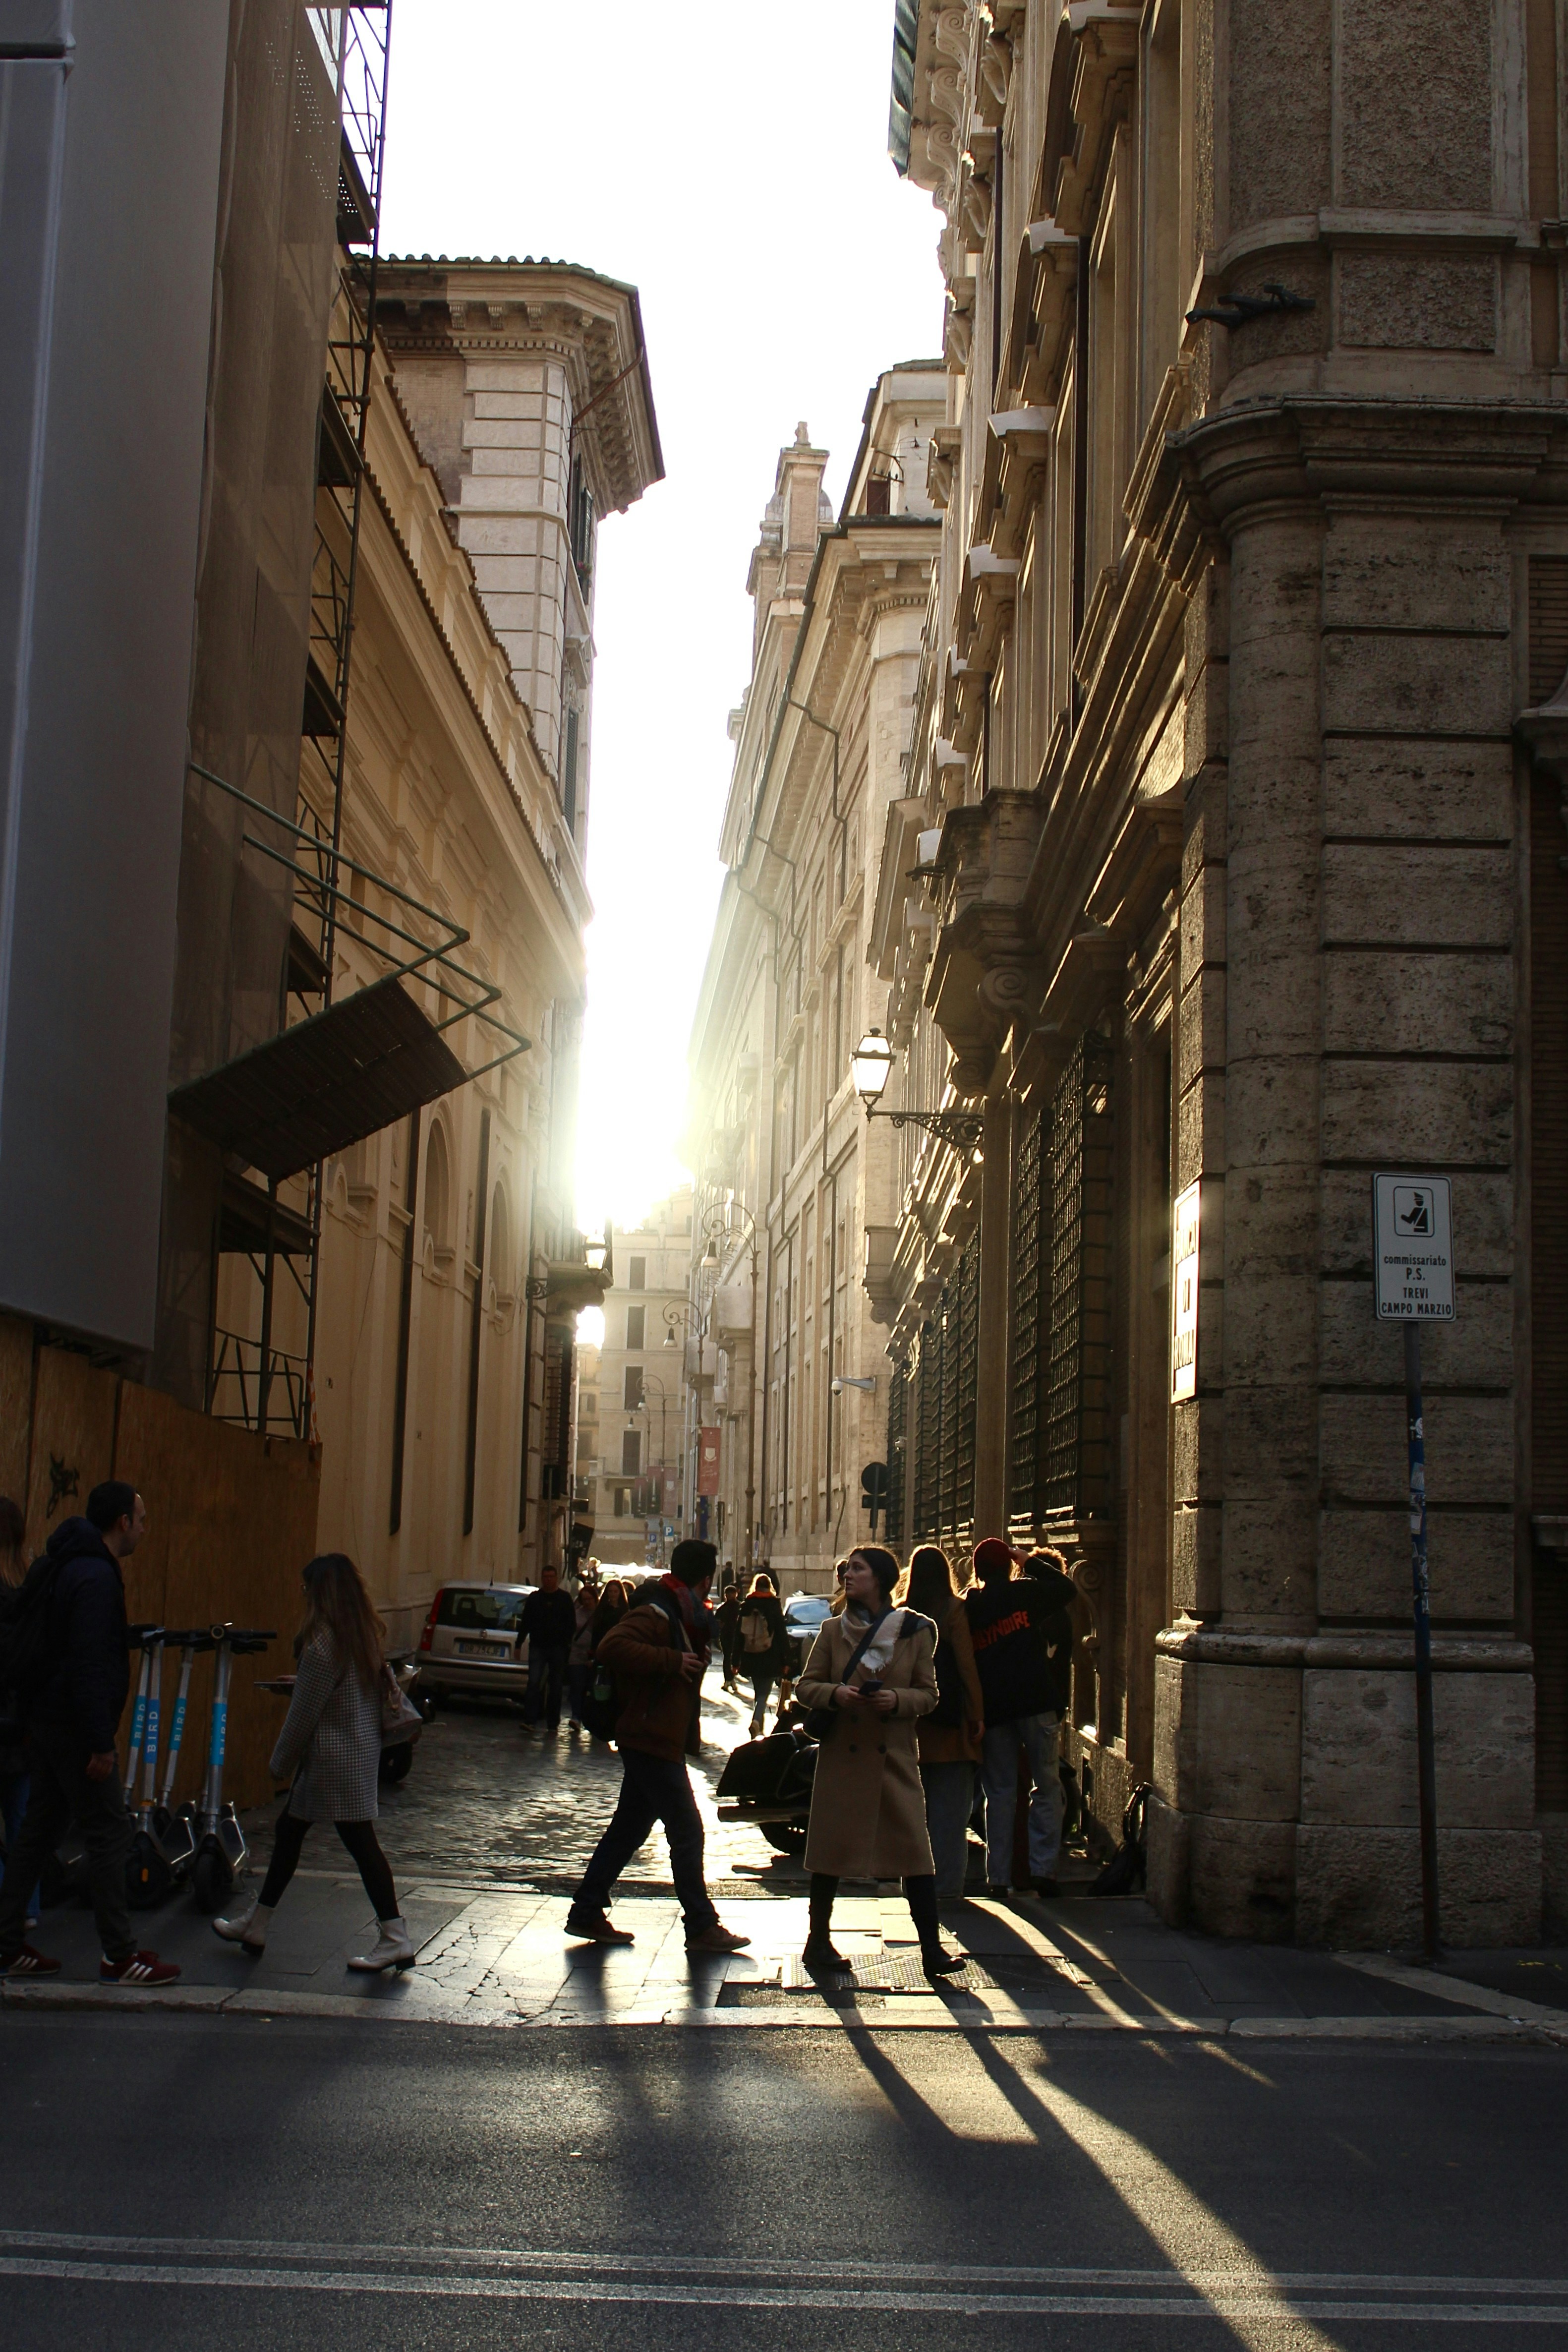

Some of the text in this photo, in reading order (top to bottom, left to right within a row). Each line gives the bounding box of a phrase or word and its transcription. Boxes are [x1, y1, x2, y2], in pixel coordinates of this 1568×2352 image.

[1176, 1221, 1196, 1264] BANCA
[1384, 1254, 1447, 1266] commissariato
[1406, 1267, 1426, 1280] P.S.
[1183, 1278, 1191, 1313] DI
[1382, 1302, 1452, 1315] CAMPO MARZIO
[1403, 1287, 1428, 1298] TREVI
[1174, 1329, 1195, 1370] ROMA
[666, 1527, 672, 1535] P
[134, 1704, 146, 1739] BIRD
[147, 1711, 158, 1753] BIRD
[174, 1706, 185, 1742] BIRD
